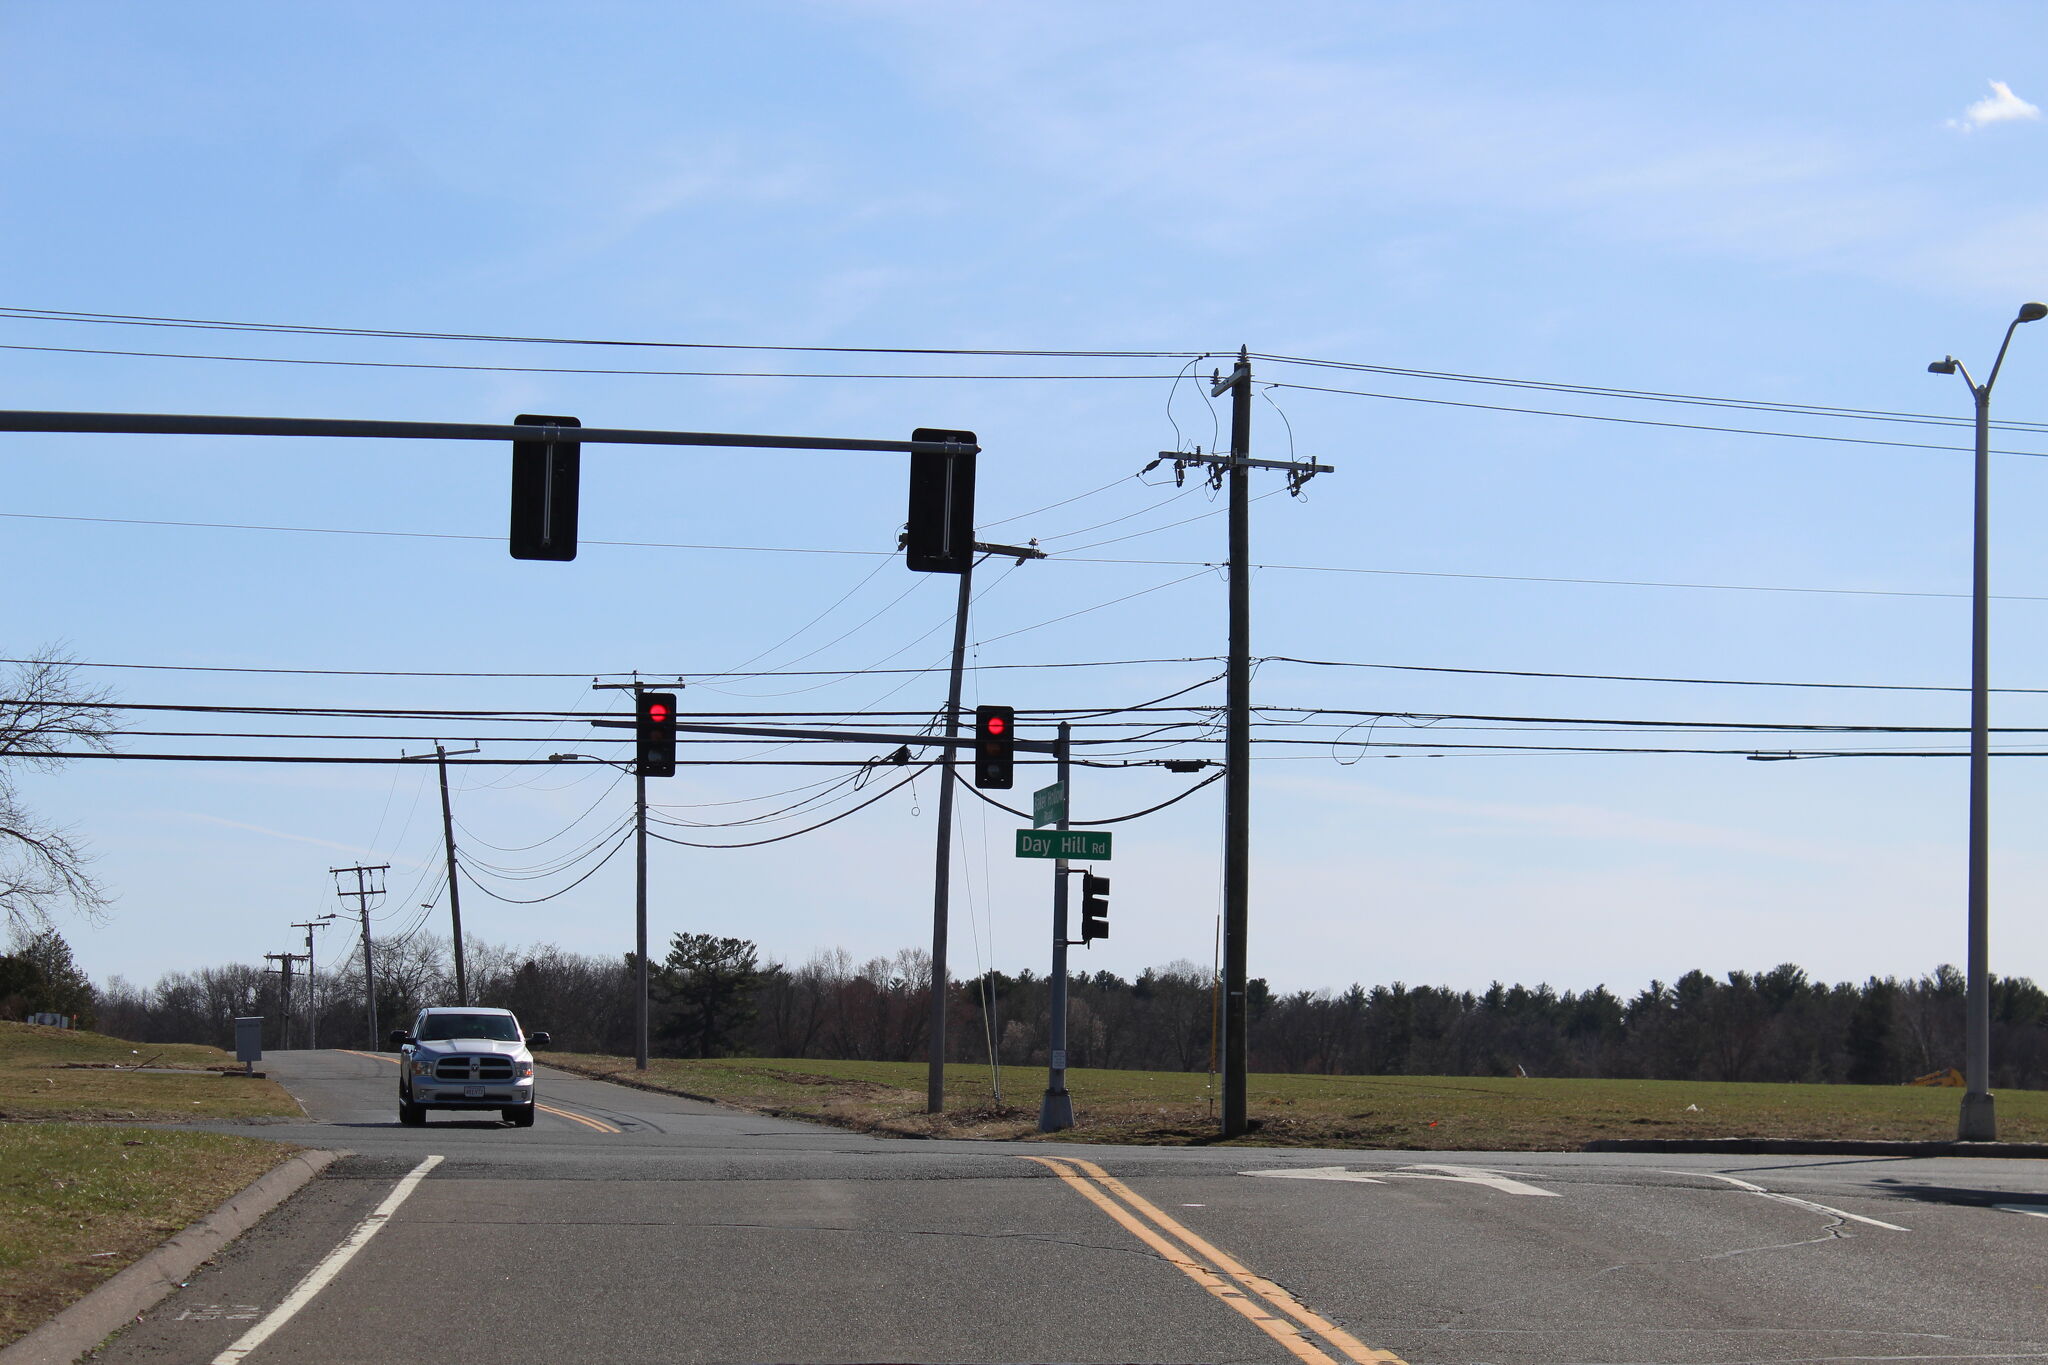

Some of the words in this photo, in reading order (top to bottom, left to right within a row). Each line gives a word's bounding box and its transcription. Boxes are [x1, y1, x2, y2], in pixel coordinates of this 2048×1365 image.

[1022, 836, 1051, 857] Day
[1061, 836, 1087, 854] Hill
[1092, 842, 1105, 854] Rd
